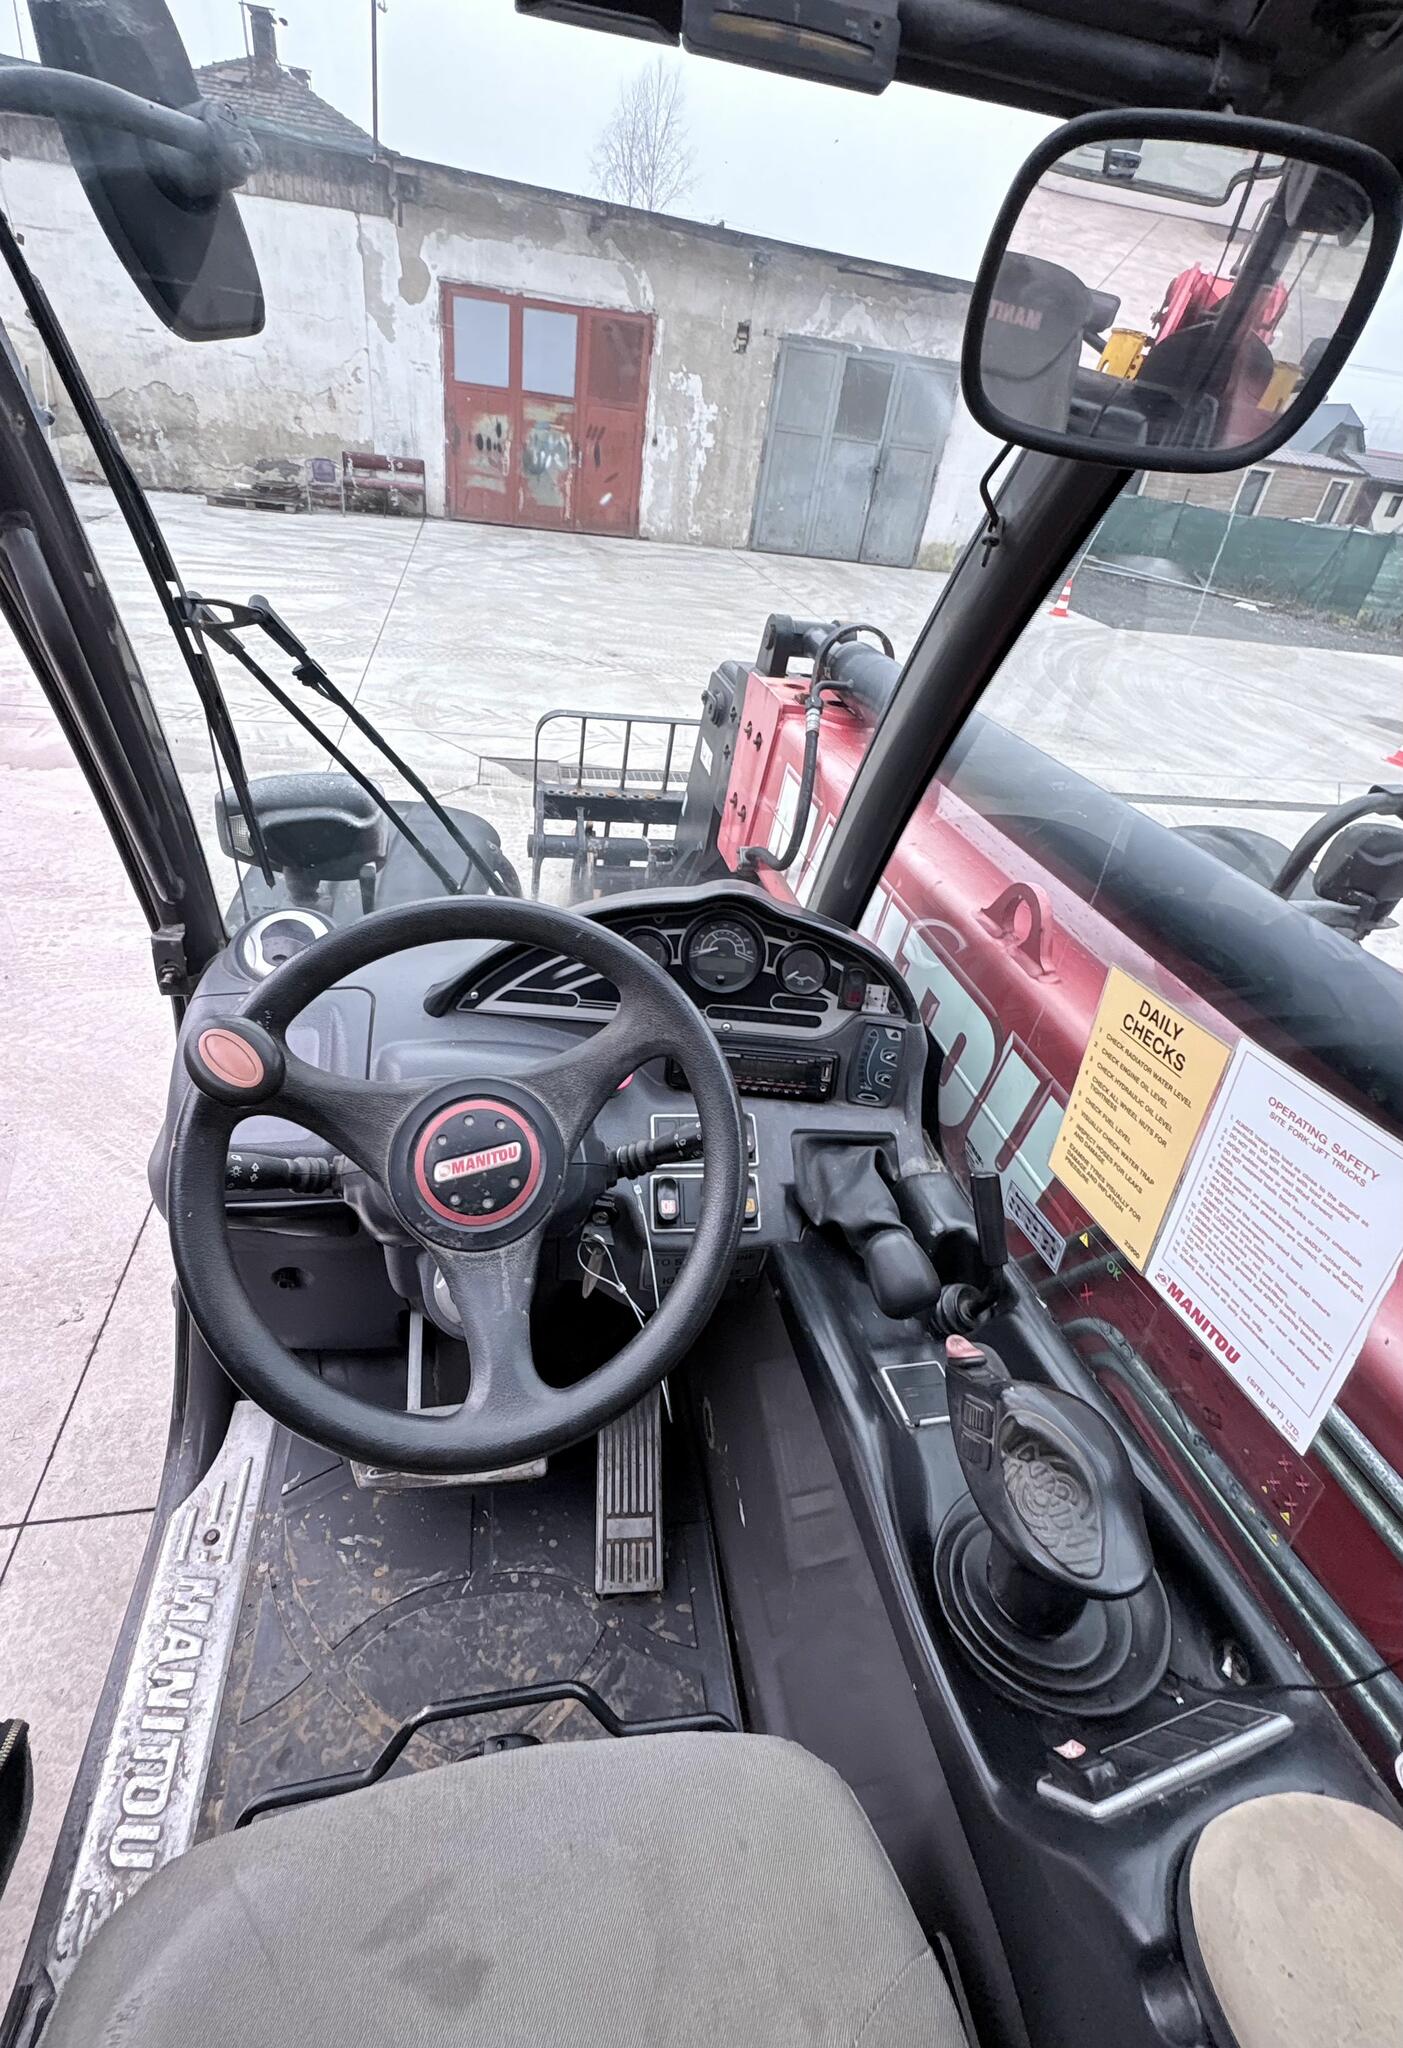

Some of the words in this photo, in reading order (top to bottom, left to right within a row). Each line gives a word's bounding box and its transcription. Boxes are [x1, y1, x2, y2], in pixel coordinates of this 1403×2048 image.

[1123, 1013, 1186, 1072] CHECKS
[1138, 1000, 1184, 1041] DAILY
[1096, 1061, 1114, 1081] CHECK
[1114, 1077, 1144, 1107] HYDRAULIC
[1144, 1103, 1154, 1117] OIL
[1154, 1113, 1173, 1134] LEVEL
[1101, 1047, 1119, 1066] CHECK
[1119, 1063, 1140, 1084] ENGINE
[1139, 1080, 1150, 1093] OIL
[1149, 1089, 1168, 1109] LEVEL
[1105, 1032, 1124, 1052] CHECK
[1124, 1048, 1152, 1075] RADIATOR
[1151, 1071, 1173, 1092] WATER
[1172, 1088, 1192, 1109] LEVEL
[1084, 1096, 1102, 1116] CHECK
[1102, 1113, 1115, 1129] FUEL
[1114, 1125, 1131, 1145] LEVEL
[1091, 1075, 1109, 1095] CHECK
[1109, 1091, 1119, 1104] ALL
[1119, 1100, 1138, 1121] WHEEL
[1138, 1118, 1154, 1136] NUTS
[1153, 1132, 1167, 1148] FOR
[1266, 1096, 1328, 1145] OPERATING
[1330, 1141, 1381, 1183] SAFETY
[452, 1145, 518, 1175] MANITOU
[1102, 1131, 1121, 1153] CHECK
[1119, 1149, 1139, 1172] WATER
[1139, 1168, 1154, 1187] TRAP
[1268, 1110, 1286, 1128] SITE
[1286, 1124, 1331, 1161] FORK-LIFT
[1330, 1156, 1367, 1188] TRUCKS
[1124, 1172, 1142, 1194] LEAKS
[1106, 1260, 1122, 1281] OK
[1166, 1281, 1241, 1365] MANITOU
[1245, 1374, 1264, 1398] (SITE
[1265, 1396, 1284, 1421] LIFT)
[1285, 1418, 1301, 1439] LTD.
[109, 1575, 220, 1871] MANITOU
